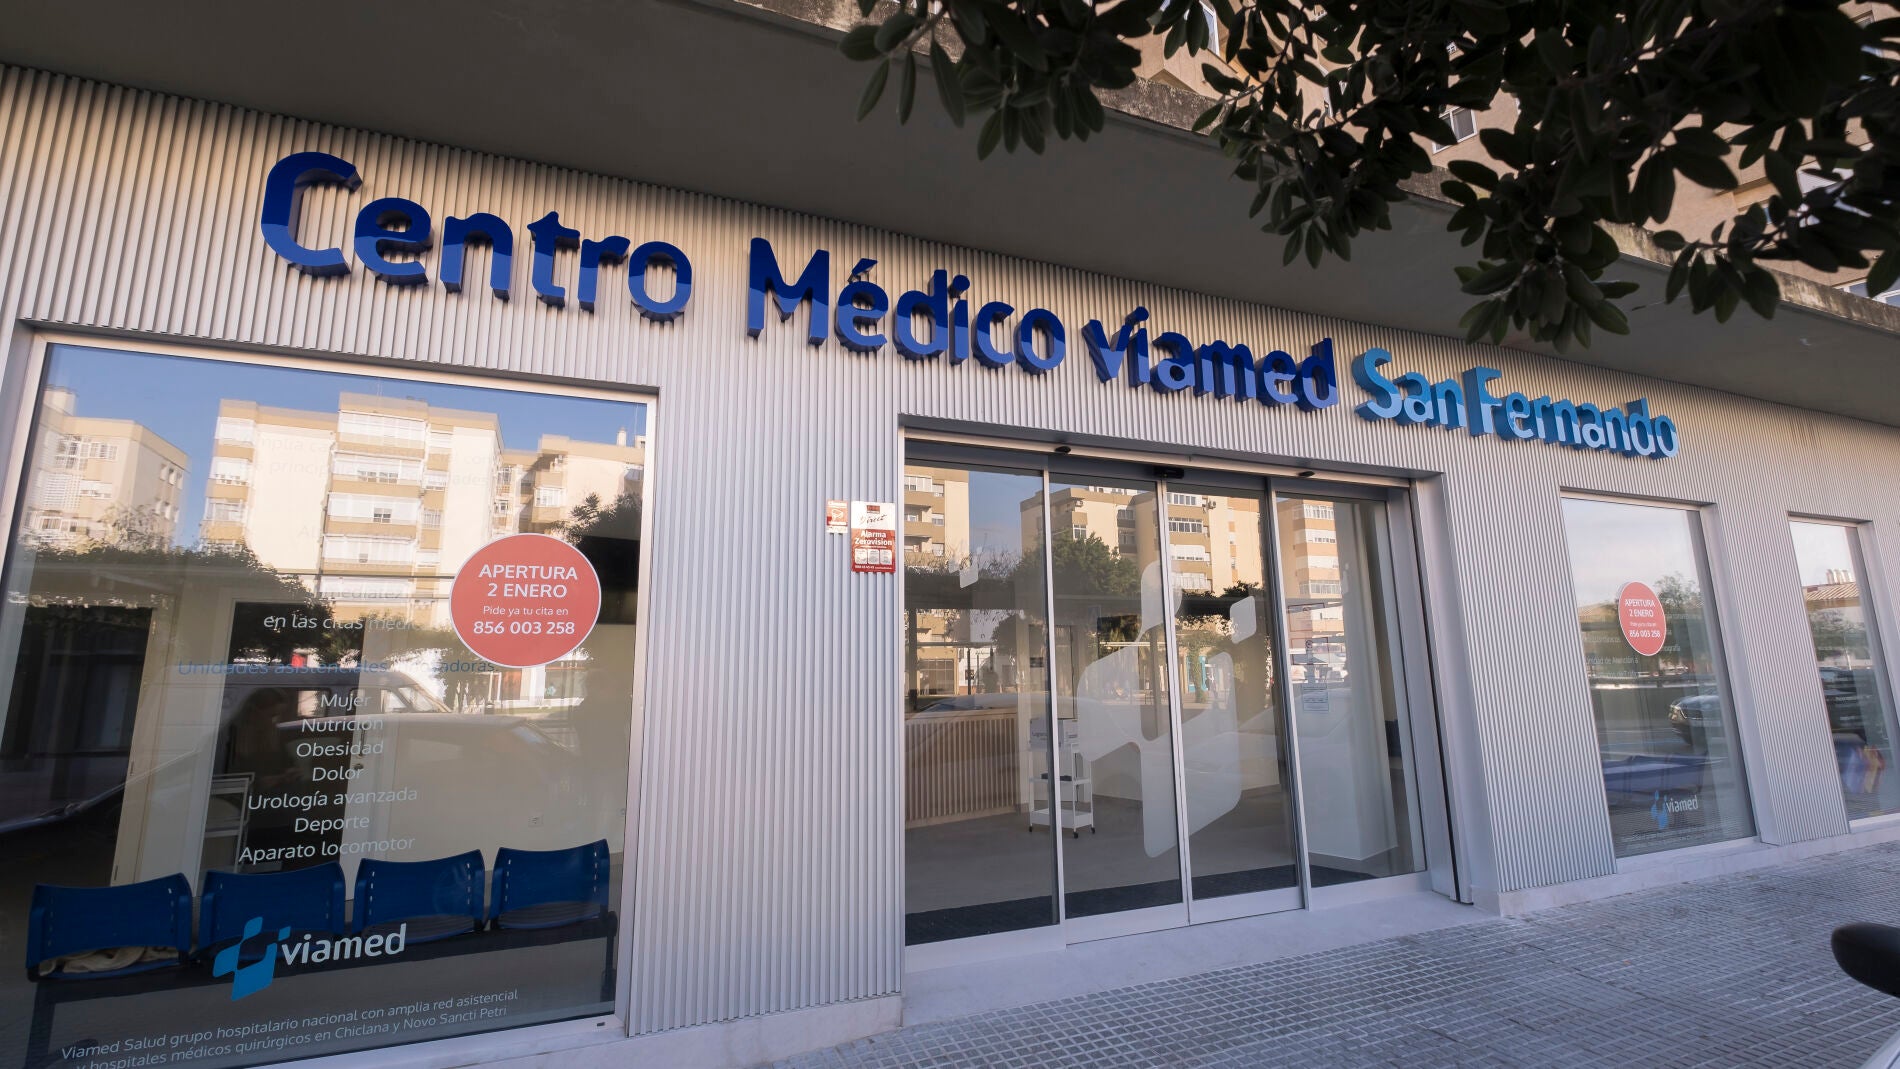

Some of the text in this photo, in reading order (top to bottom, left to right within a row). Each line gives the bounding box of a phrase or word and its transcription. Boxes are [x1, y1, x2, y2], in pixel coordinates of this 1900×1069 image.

[261, 151, 692, 321] Centro
[747, 237, 1066, 374] Médico
[1353, 347, 1467, 430] San
[1462, 366, 1679, 460] Fernando
[855, 538, 892, 546] Zerovision
[861, 530, 886, 538] Alarma
[478, 564, 578, 580] APERTURA
[487, 583, 568, 598] 2 ENERO
[1625, 598, 1655, 607] APERTURA
[483, 605, 569, 617] Pide ya tu cita en
[1628, 609, 1654, 617] 2 ENERO
[263, 616, 286, 629] en
[291, 613, 318, 629] las
[323, 615, 363, 630] citas
[473, 621, 575, 635] 856 003 258
[178, 656, 271, 675] Unidades
[275, 658, 388, 675] asistenciales
[320, 693, 371, 709] Mujer
[301, 716, 384, 732] Nutrición
[296, 740, 384, 757] Obesidad
[312, 766, 364, 782] Dolor
[248, 787, 418, 811] Urología avanzada
[1665, 794, 1699, 813] viamed
[294, 816, 370, 835] Deporte
[238, 838, 416, 865] Aparato locomotor
[281, 923, 407, 966] viamed
[61, 989, 519, 1060] Viamed Salud grupo hospitalario nacional con amplia red asistencial
[89, 1051, 167, 1069] hospitales
[171, 1043, 231, 1062] médicos
[235, 1033, 311, 1053] quirúrgicos
[315, 1030, 331, 1042] en
[335, 1024, 389, 1040] Chiclana
[391, 1022, 400, 1034] y
[403, 1017, 436, 1030] Novo
[439, 1010, 476, 1025] Sancti
[480, 1005, 508, 1019] Petri
